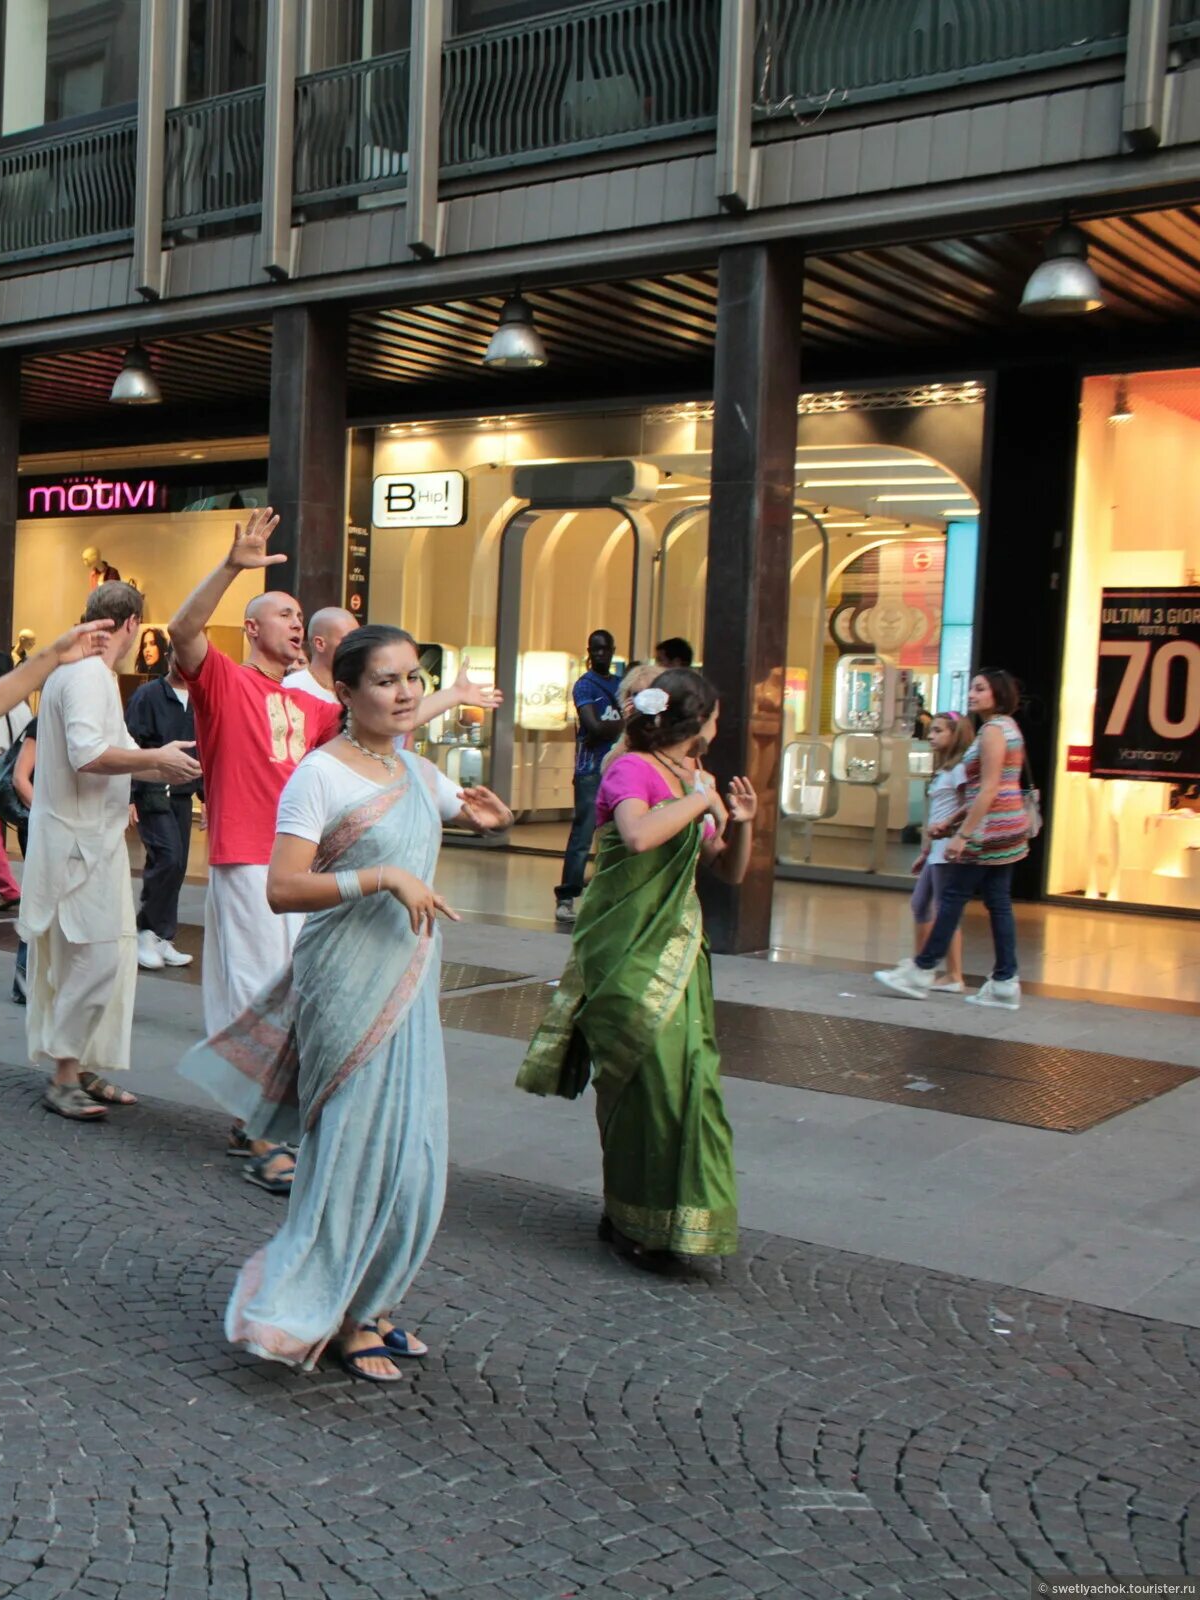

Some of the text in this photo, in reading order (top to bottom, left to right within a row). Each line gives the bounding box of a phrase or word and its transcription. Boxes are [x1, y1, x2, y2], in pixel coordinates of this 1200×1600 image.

[1102, 608, 1151, 624] ULTIMI
[1153, 608, 1165, 624] 3
[1137, 625, 1167, 636] TUTTO
[1099, 641, 1200, 739] 70
